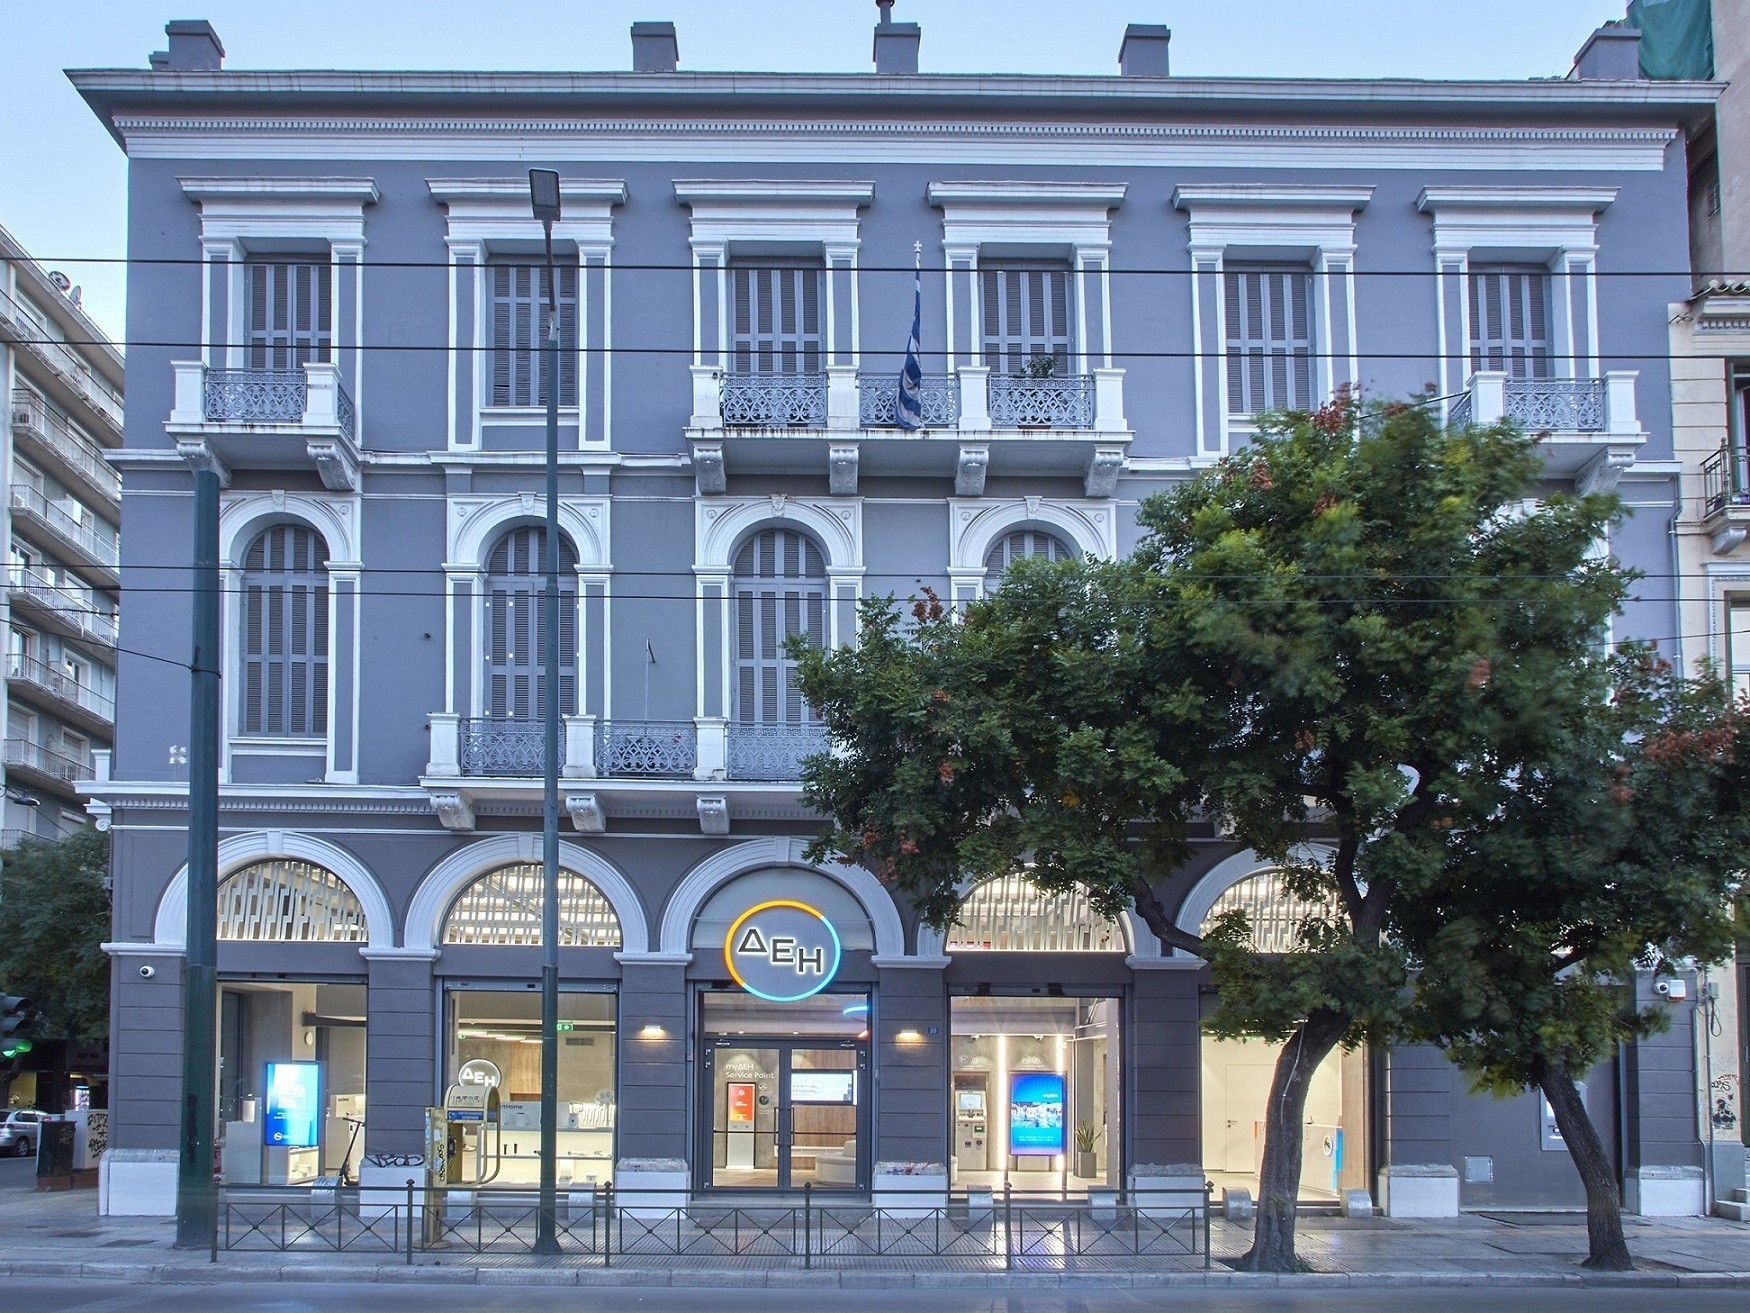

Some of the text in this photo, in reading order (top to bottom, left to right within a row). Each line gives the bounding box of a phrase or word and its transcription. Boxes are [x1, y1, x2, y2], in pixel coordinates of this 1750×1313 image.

[737, 927, 823, 974] ΔΕΗ
[461, 1068, 496, 1087] ΔΕΗ
[725, 1071, 775, 1079] Service Point
